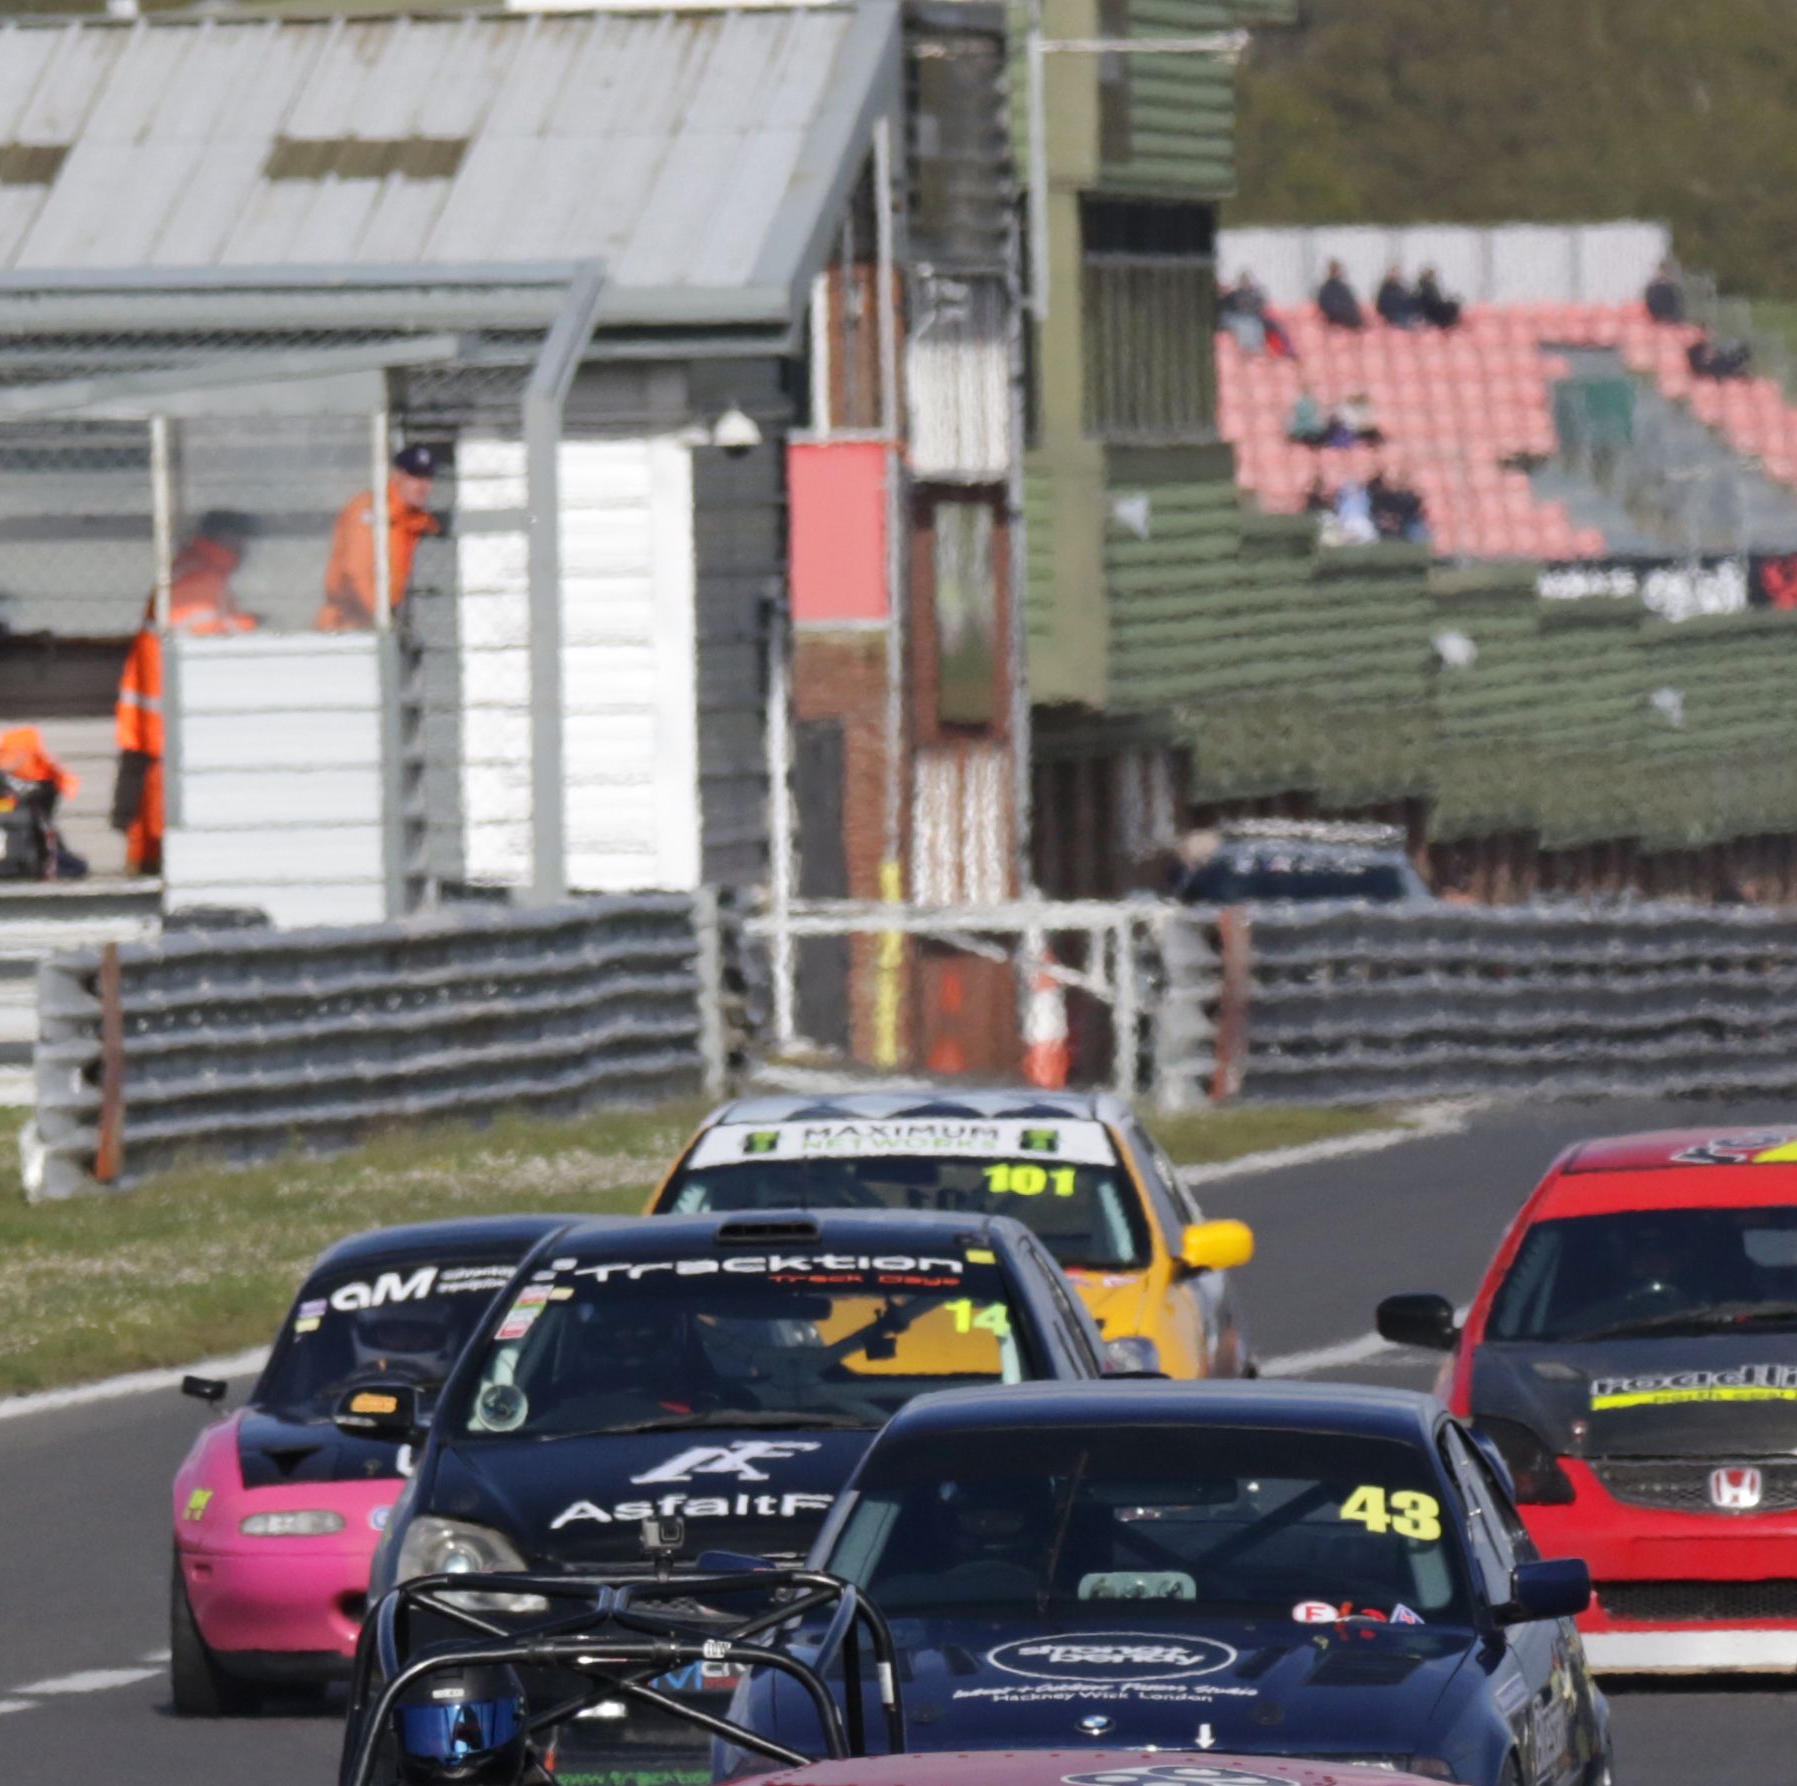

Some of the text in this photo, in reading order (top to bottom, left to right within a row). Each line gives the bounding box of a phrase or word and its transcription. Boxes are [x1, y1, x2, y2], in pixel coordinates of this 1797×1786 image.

[803, 1139, 996, 1151] NETWORKS
[804, 1124, 999, 1141] MAXIMUM
[983, 1164, 1077, 1197] 101
[574, 1254, 963, 1283] Tracktion
[330, 1266, 439, 1311] aM
[944, 1297, 1011, 1337] 14
[549, 1494, 834, 1529] AsfaltF
[1340, 1485, 1442, 1541] 43
[992, 1691, 1213, 1702] Hackney Wick London
